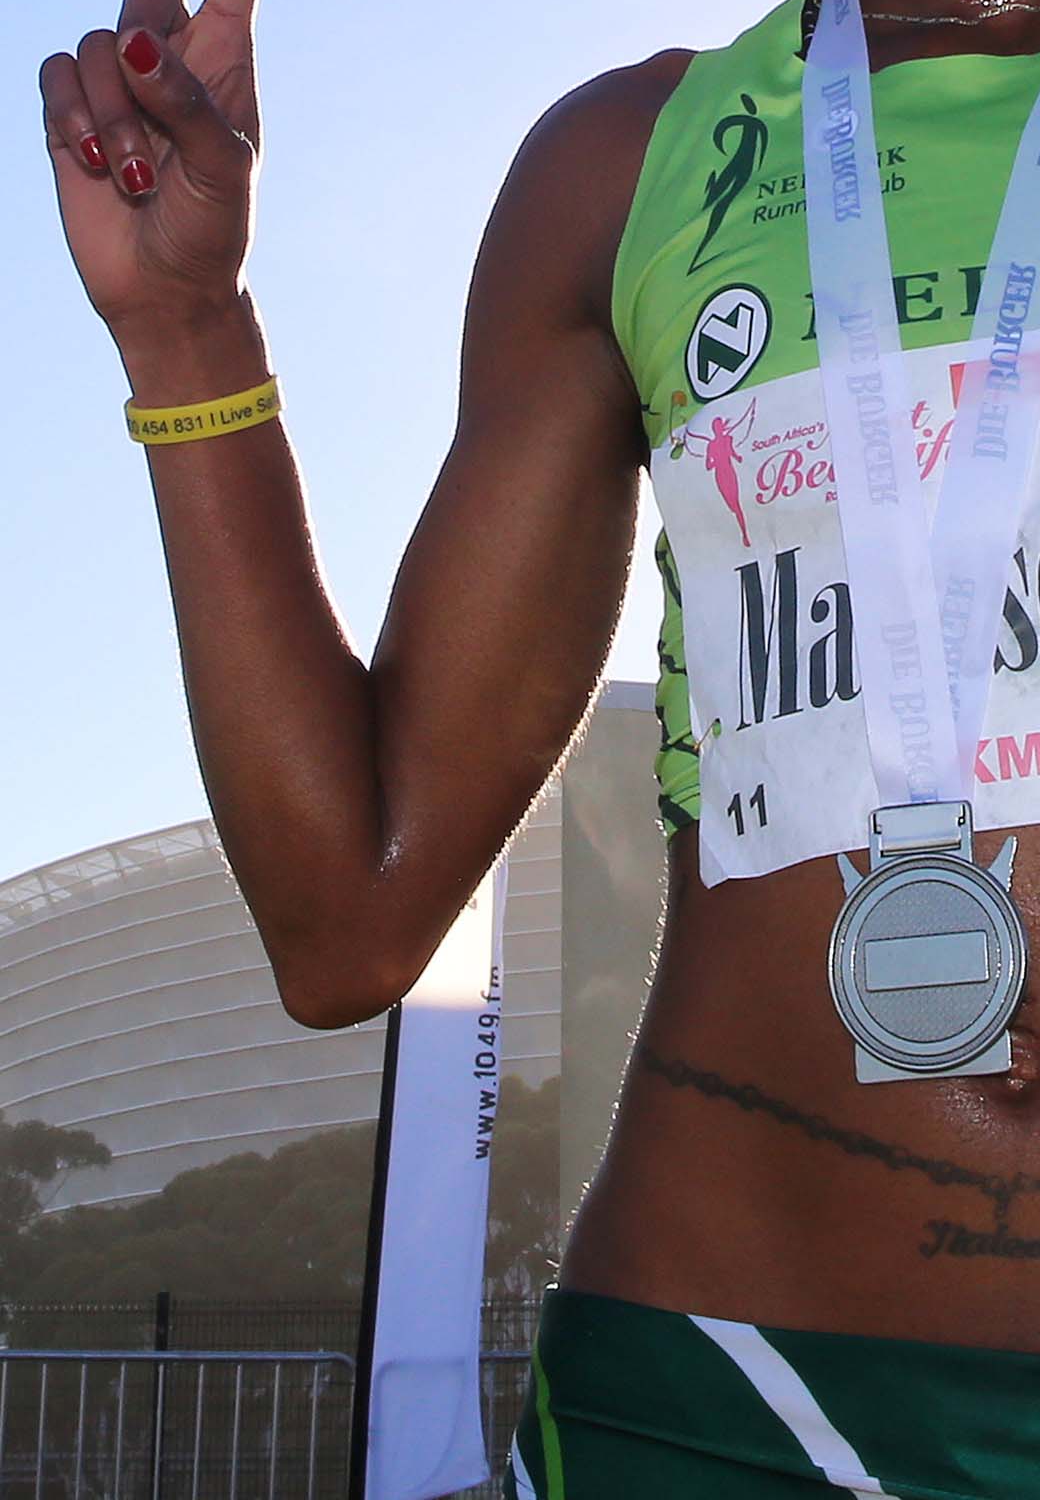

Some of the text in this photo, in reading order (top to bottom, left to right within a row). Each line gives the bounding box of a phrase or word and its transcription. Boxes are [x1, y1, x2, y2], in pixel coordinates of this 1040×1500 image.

[142, 421, 168, 436] 454
[174, 416, 203, 433] 831
[220, 406, 253, 425] Live
[752, 422, 824, 452] South Africa's
[727, 784, 769, 837] 11
[474, 966, 501, 1160] www.1049.fm
